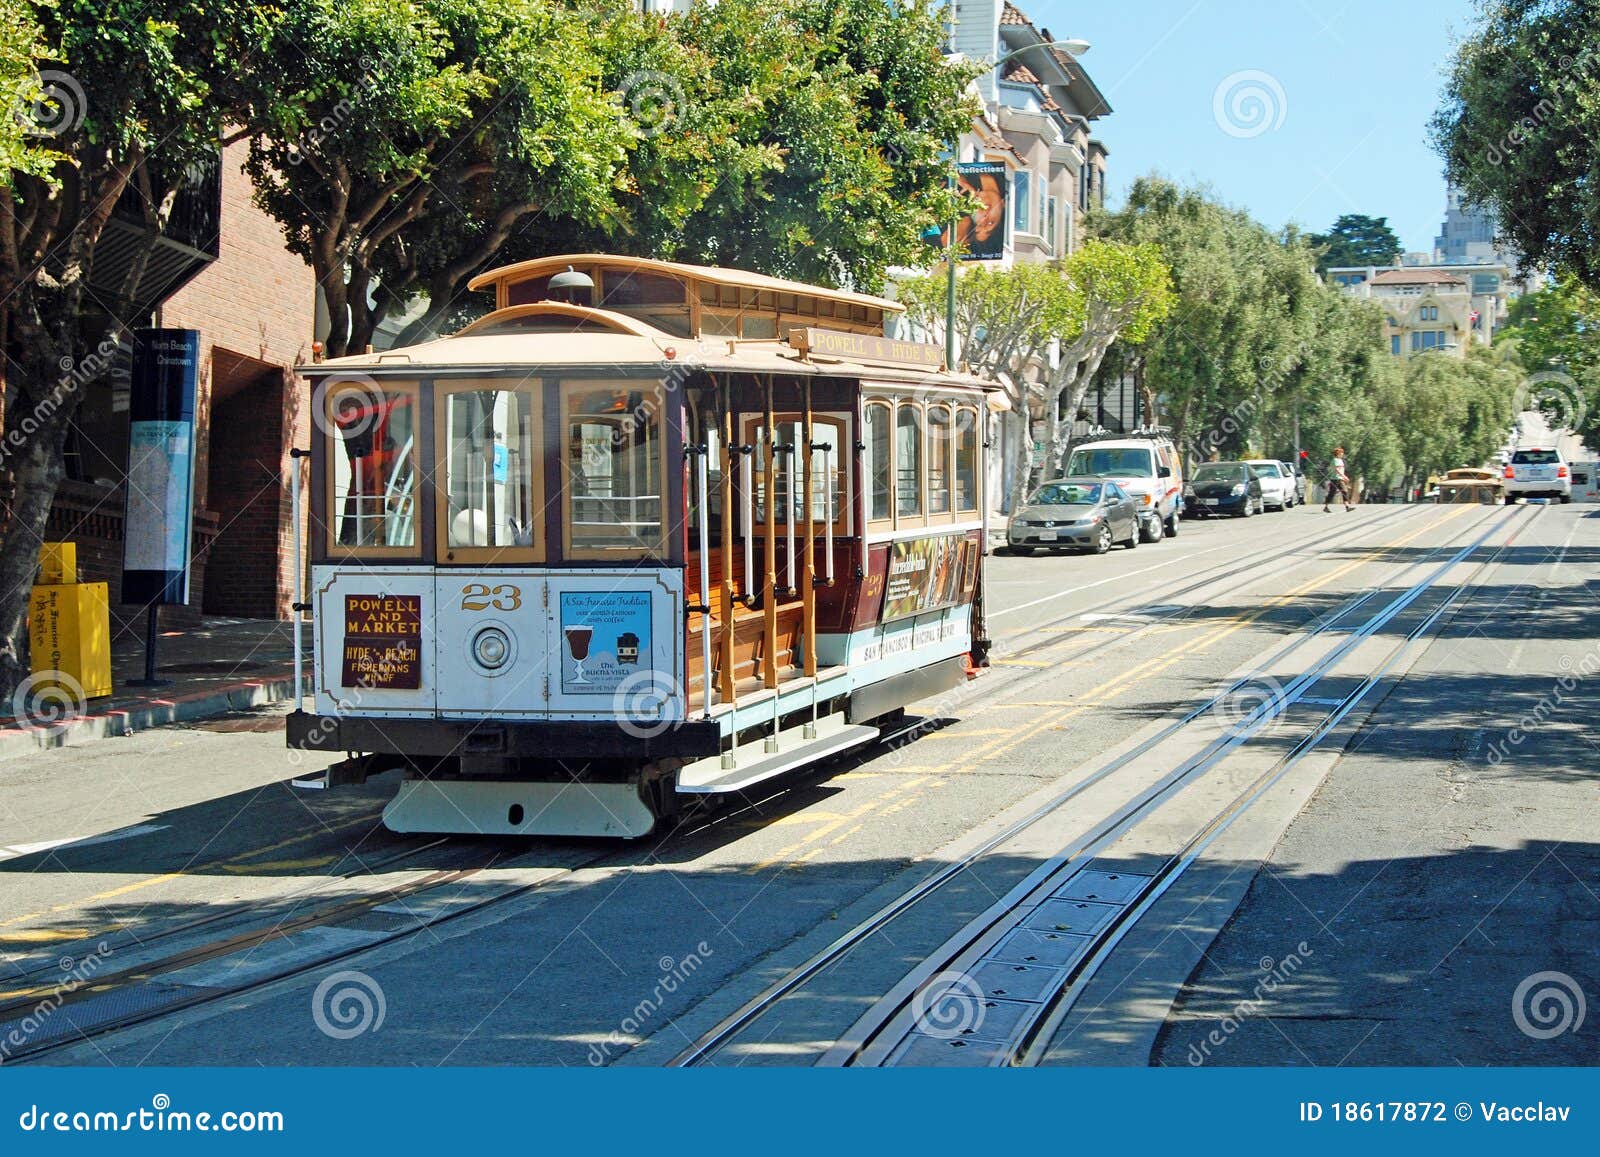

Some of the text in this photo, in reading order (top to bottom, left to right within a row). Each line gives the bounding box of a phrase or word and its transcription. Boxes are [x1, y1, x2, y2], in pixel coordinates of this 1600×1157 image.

[959, 166, 1004, 174] Reflections
[171, 340, 192, 351] Beach
[815, 333, 866, 355] POWELL
[892, 343, 920, 361] HYDE
[157, 354, 192, 366] Chinatown
[461, 583, 521, 611] 23
[349, 600, 417, 611] POWELL
[367, 612, 401, 621] AND
[50, 611, 59, 648] Francisco
[348, 621, 419, 633] MARKET
[346, 647, 370, 660] HYDE
[385, 648, 416, 661] BEACH
[864, 643, 876, 661] SAN
[351, 663, 409, 673] FISHERMANS
